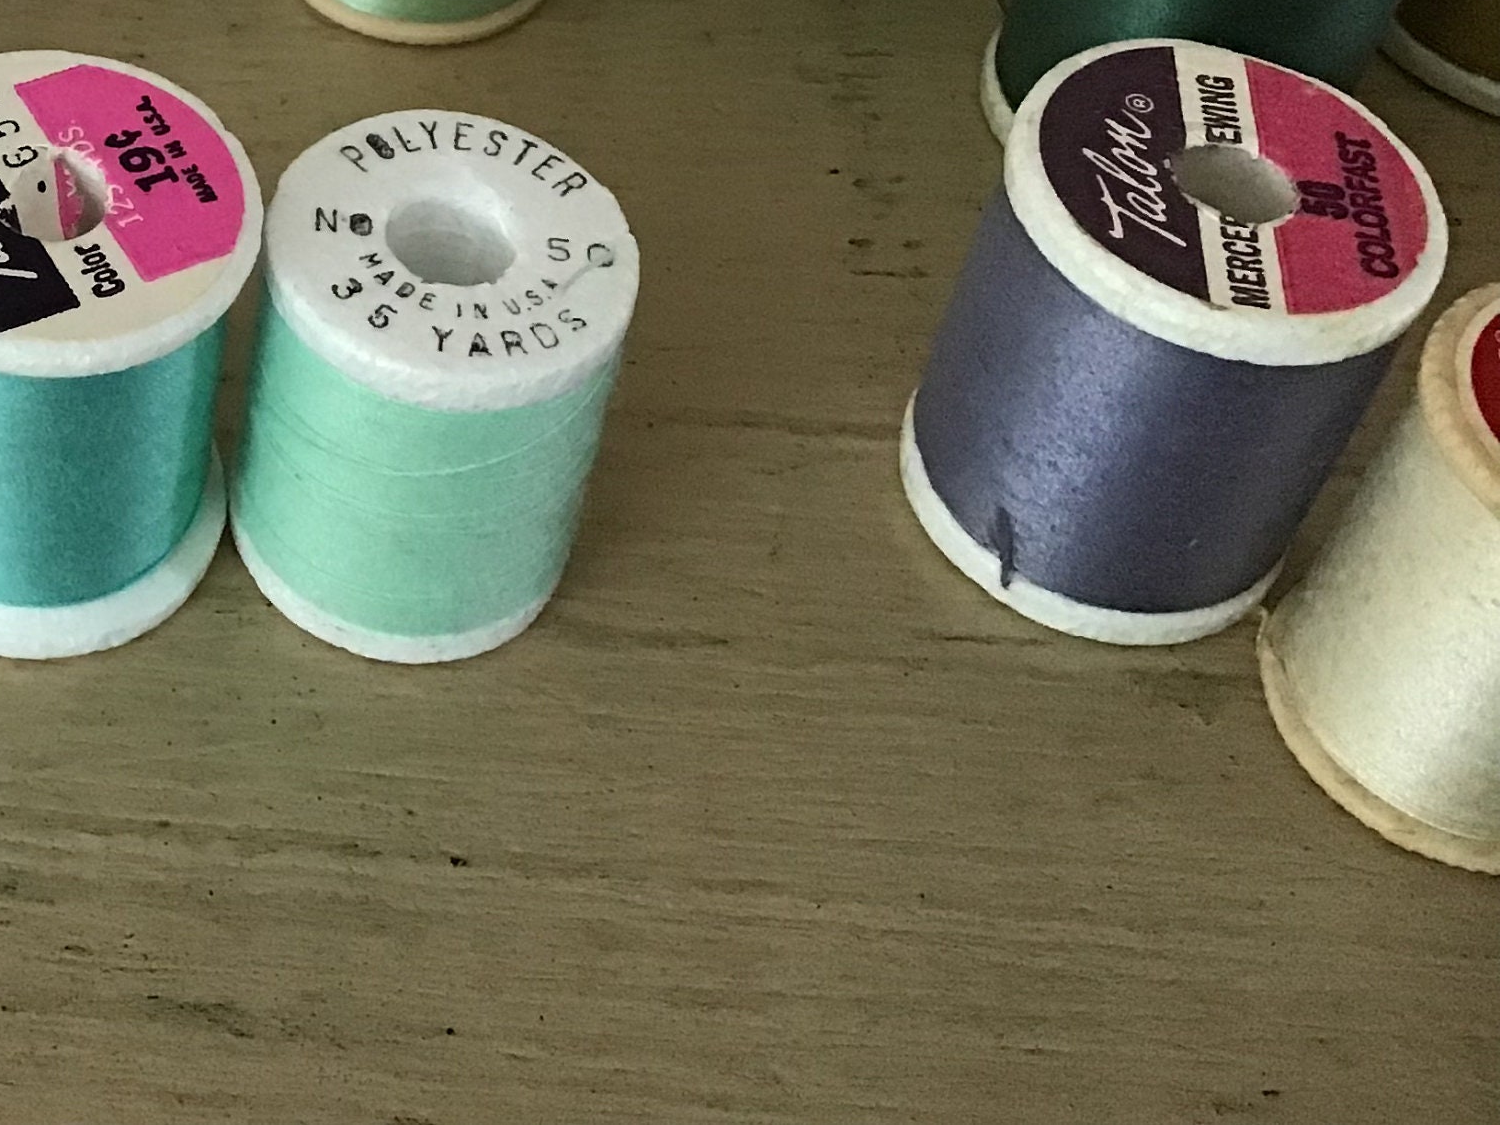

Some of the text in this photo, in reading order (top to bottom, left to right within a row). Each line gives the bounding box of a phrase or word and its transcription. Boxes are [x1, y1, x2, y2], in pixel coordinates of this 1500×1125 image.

[164, 139, 186, 159] IN
[181, 163, 218, 202] MADE
[339, 120, 588, 198] POLYESTER
[1082, 108, 1188, 249] Talon
[1296, 179, 1350, 220] 50
[1335, 131, 1399, 278] COLORFAST
[74, 243, 125, 299] Color
[359, 252, 437, 310] MADE
[456, 303, 489, 320] IN
[331, 277, 587, 357] 35 YARDS
